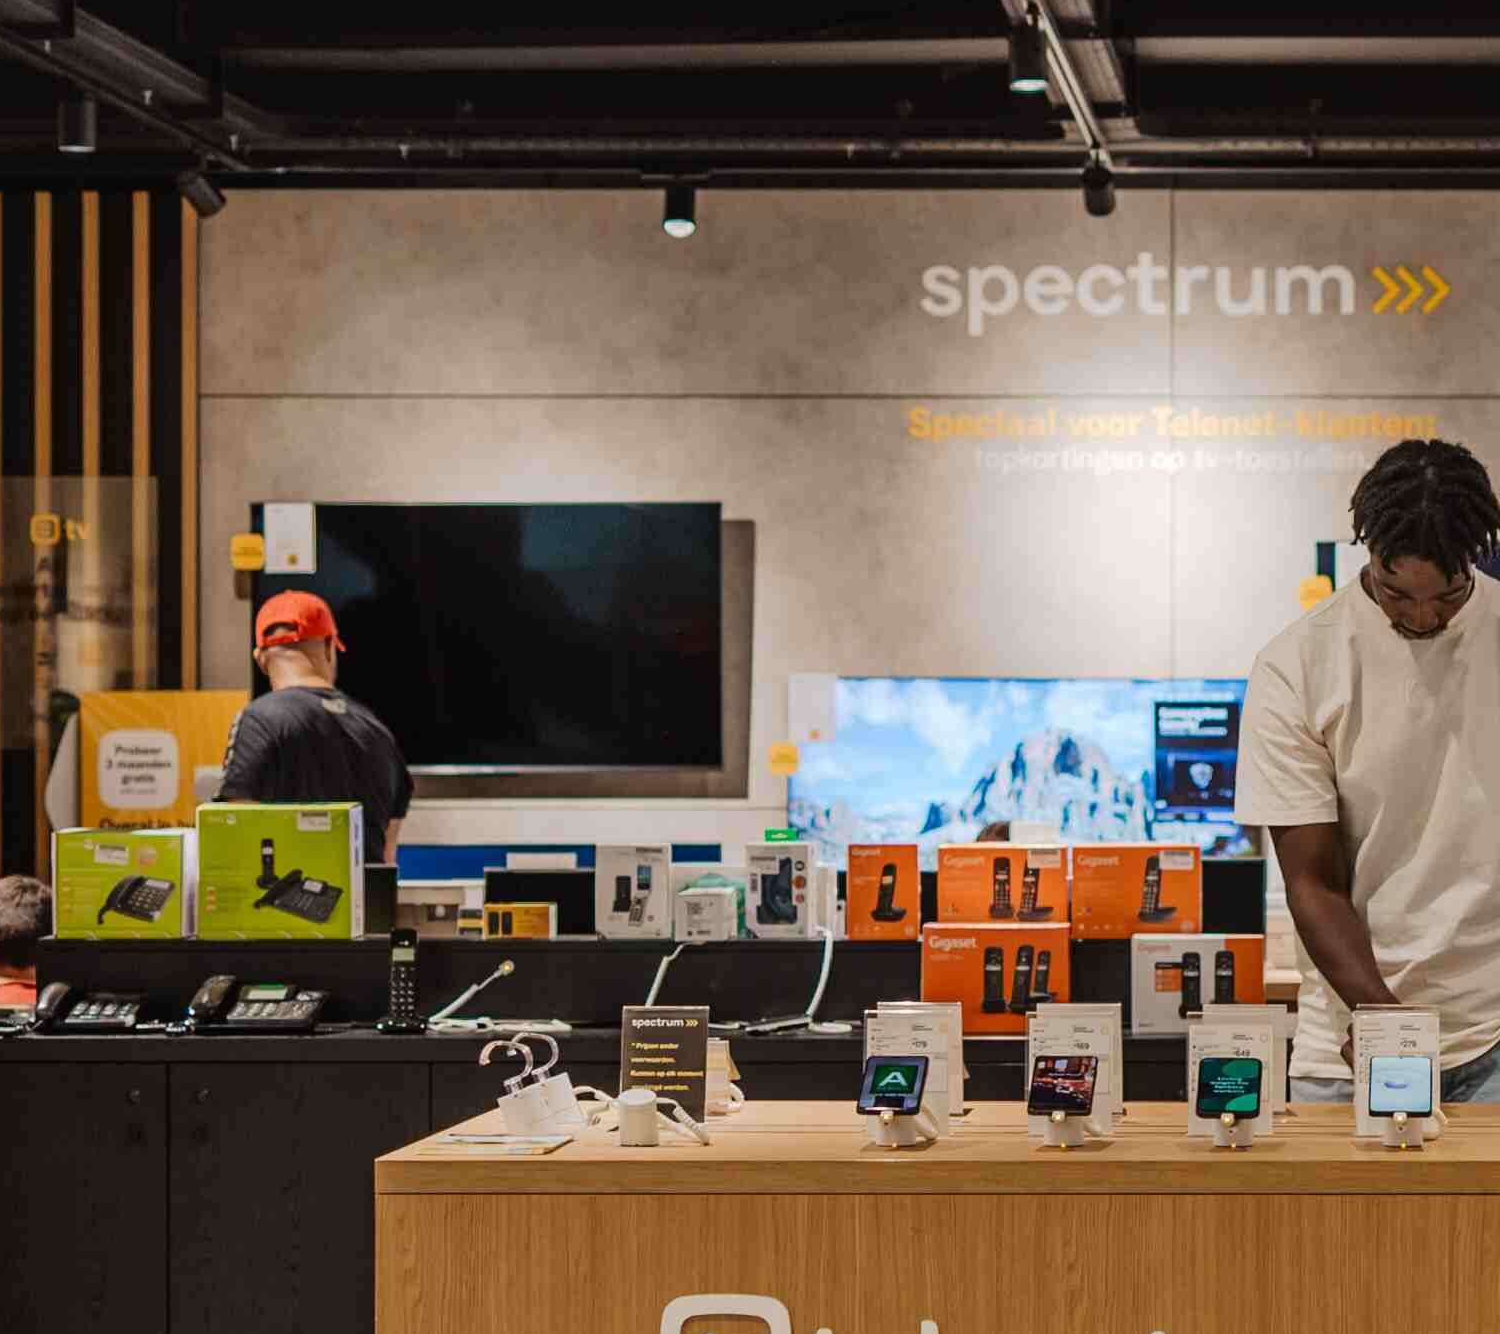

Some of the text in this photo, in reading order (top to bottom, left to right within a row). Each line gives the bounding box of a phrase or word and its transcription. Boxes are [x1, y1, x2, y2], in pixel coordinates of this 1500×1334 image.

[920, 252, 1356, 336] spectrum
[908, 406, 1057, 442] Speciaal
[1066, 413, 1142, 437] voor
[929, 936, 977, 952] Gigaset
[631, 1018, 685, 1029] spectrum
